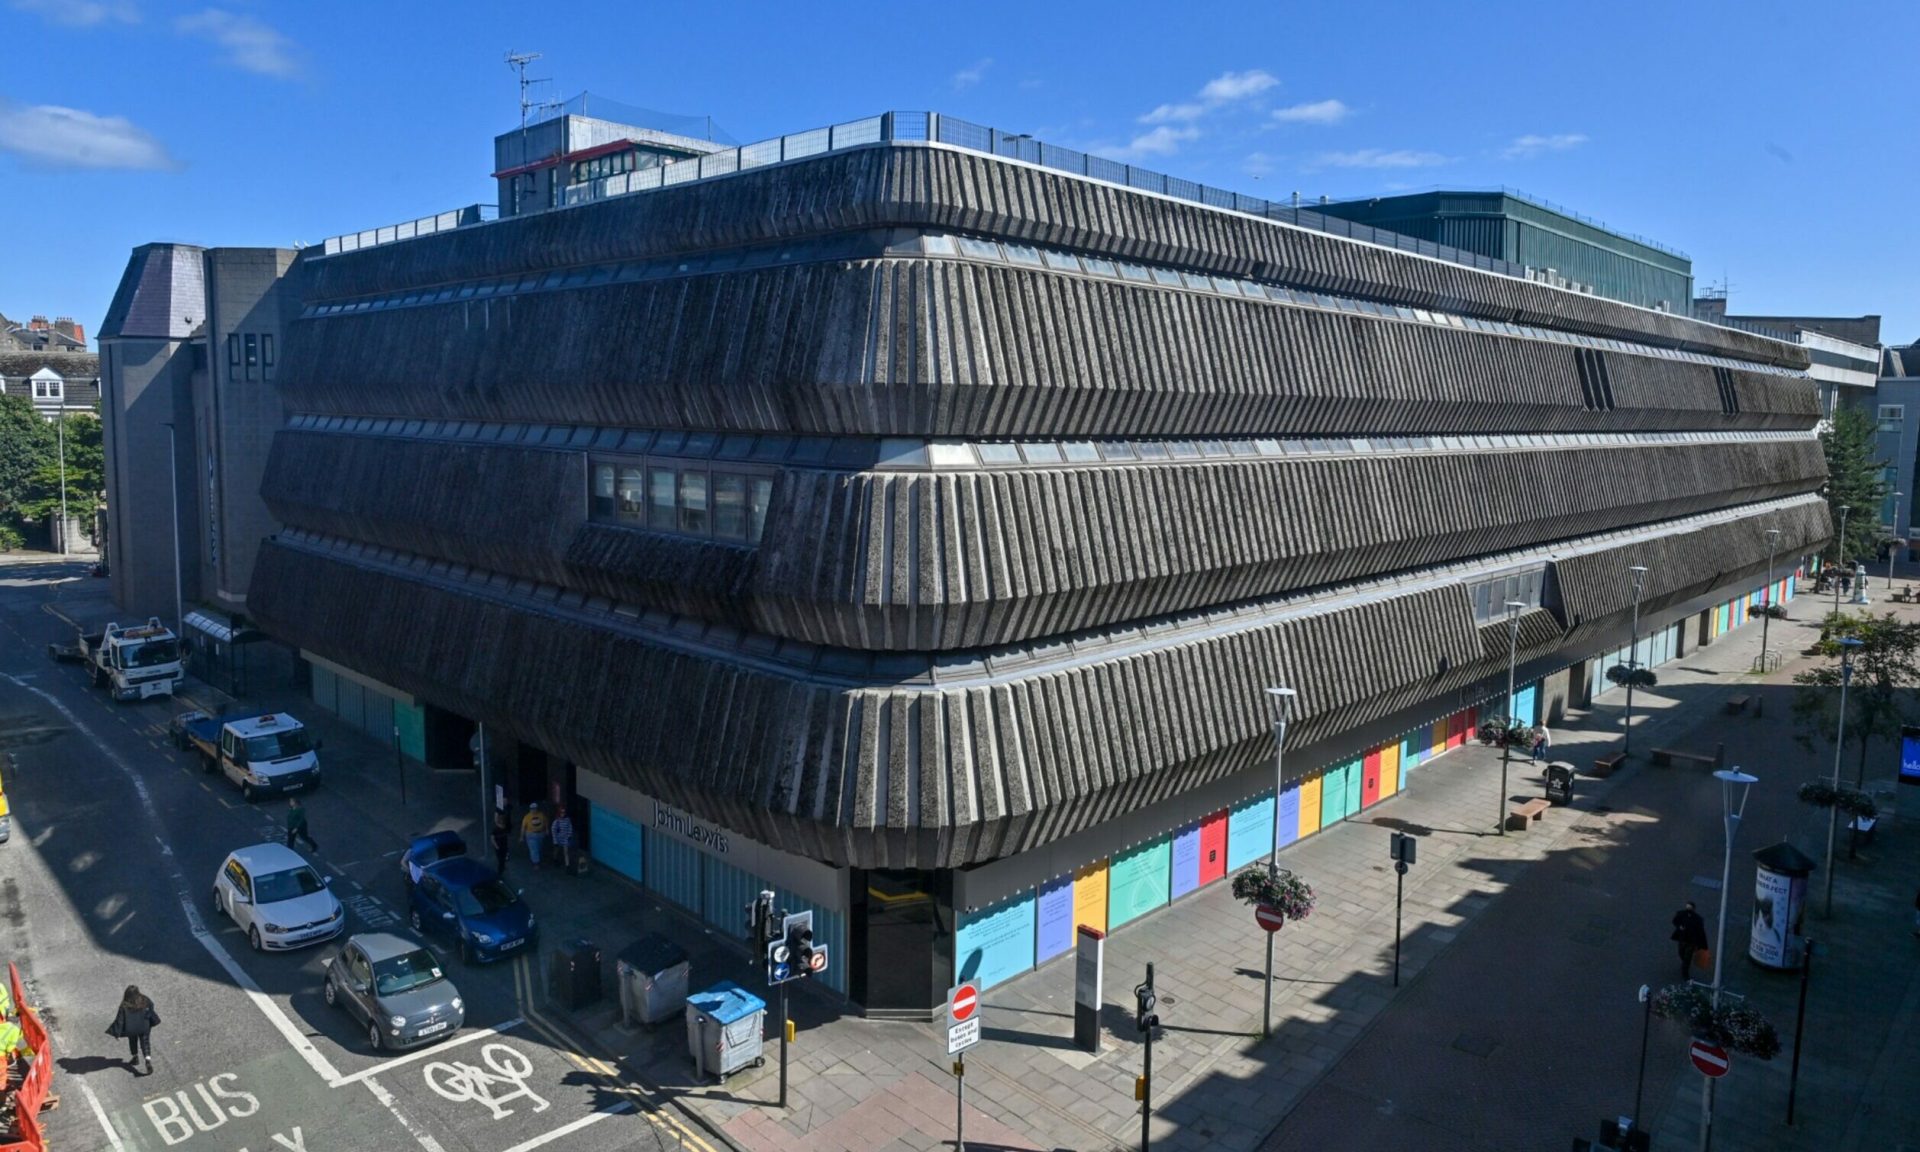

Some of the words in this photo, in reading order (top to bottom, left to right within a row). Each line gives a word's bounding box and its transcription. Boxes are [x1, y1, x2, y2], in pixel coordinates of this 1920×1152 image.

[653, 801, 685, 835] John
[687, 815, 729, 853] Lewis
[955, 1022, 973, 1033] Except
[968, 1027, 977, 1035] and
[955, 1038, 972, 1047] cycles
[142, 1073, 260, 1146] BUS
